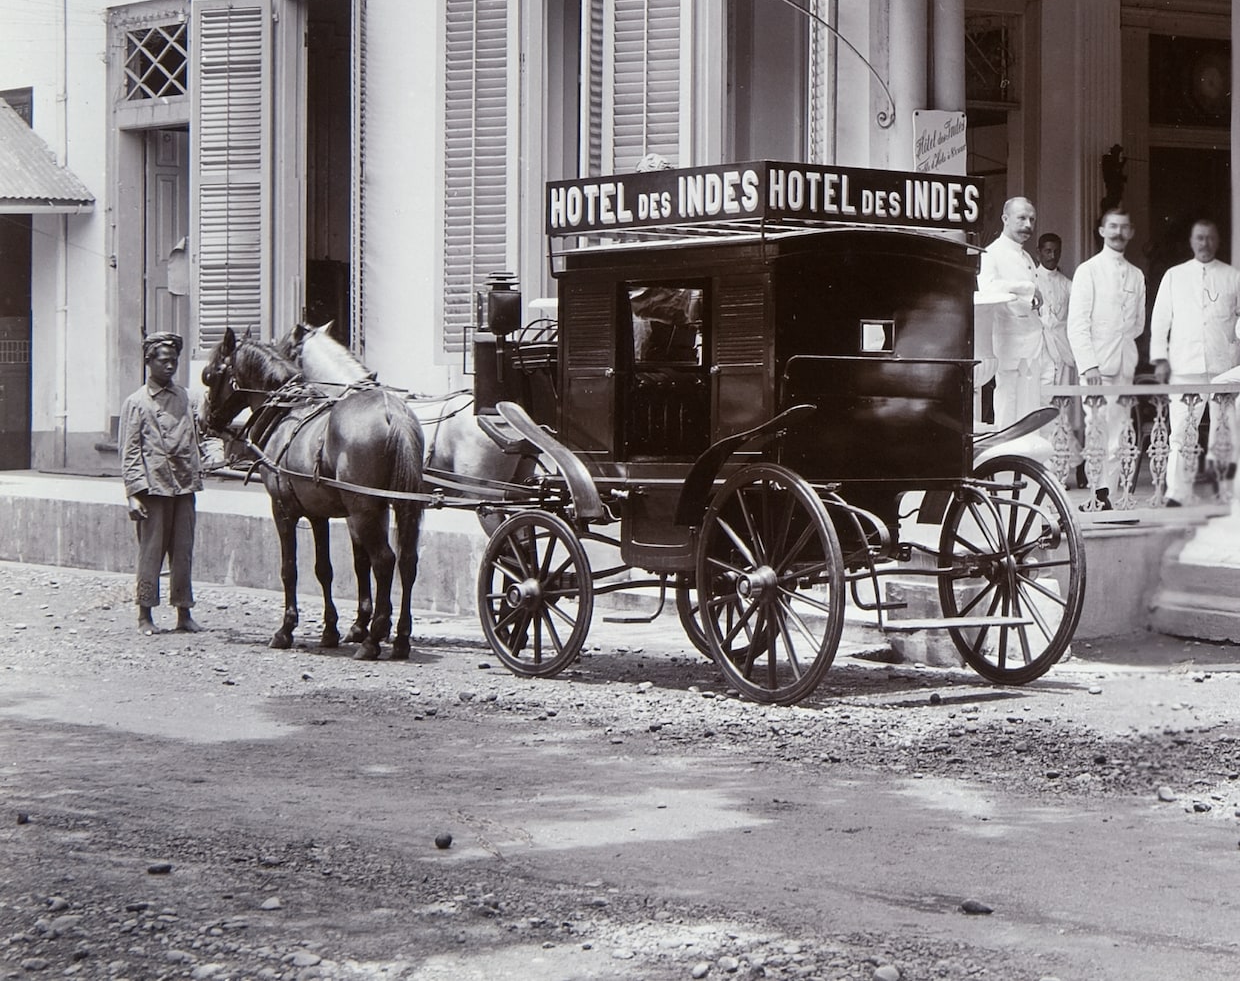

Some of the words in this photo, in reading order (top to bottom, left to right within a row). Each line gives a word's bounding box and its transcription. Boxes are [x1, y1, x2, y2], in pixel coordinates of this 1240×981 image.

[551, 182, 633, 228] HOTEL
[638, 192, 671, 220] DES
[678, 170, 759, 218] INDES
[769, 169, 857, 216] HOTEL
[861, 189, 901, 217] DES
[905, 180, 979, 223] INDES
